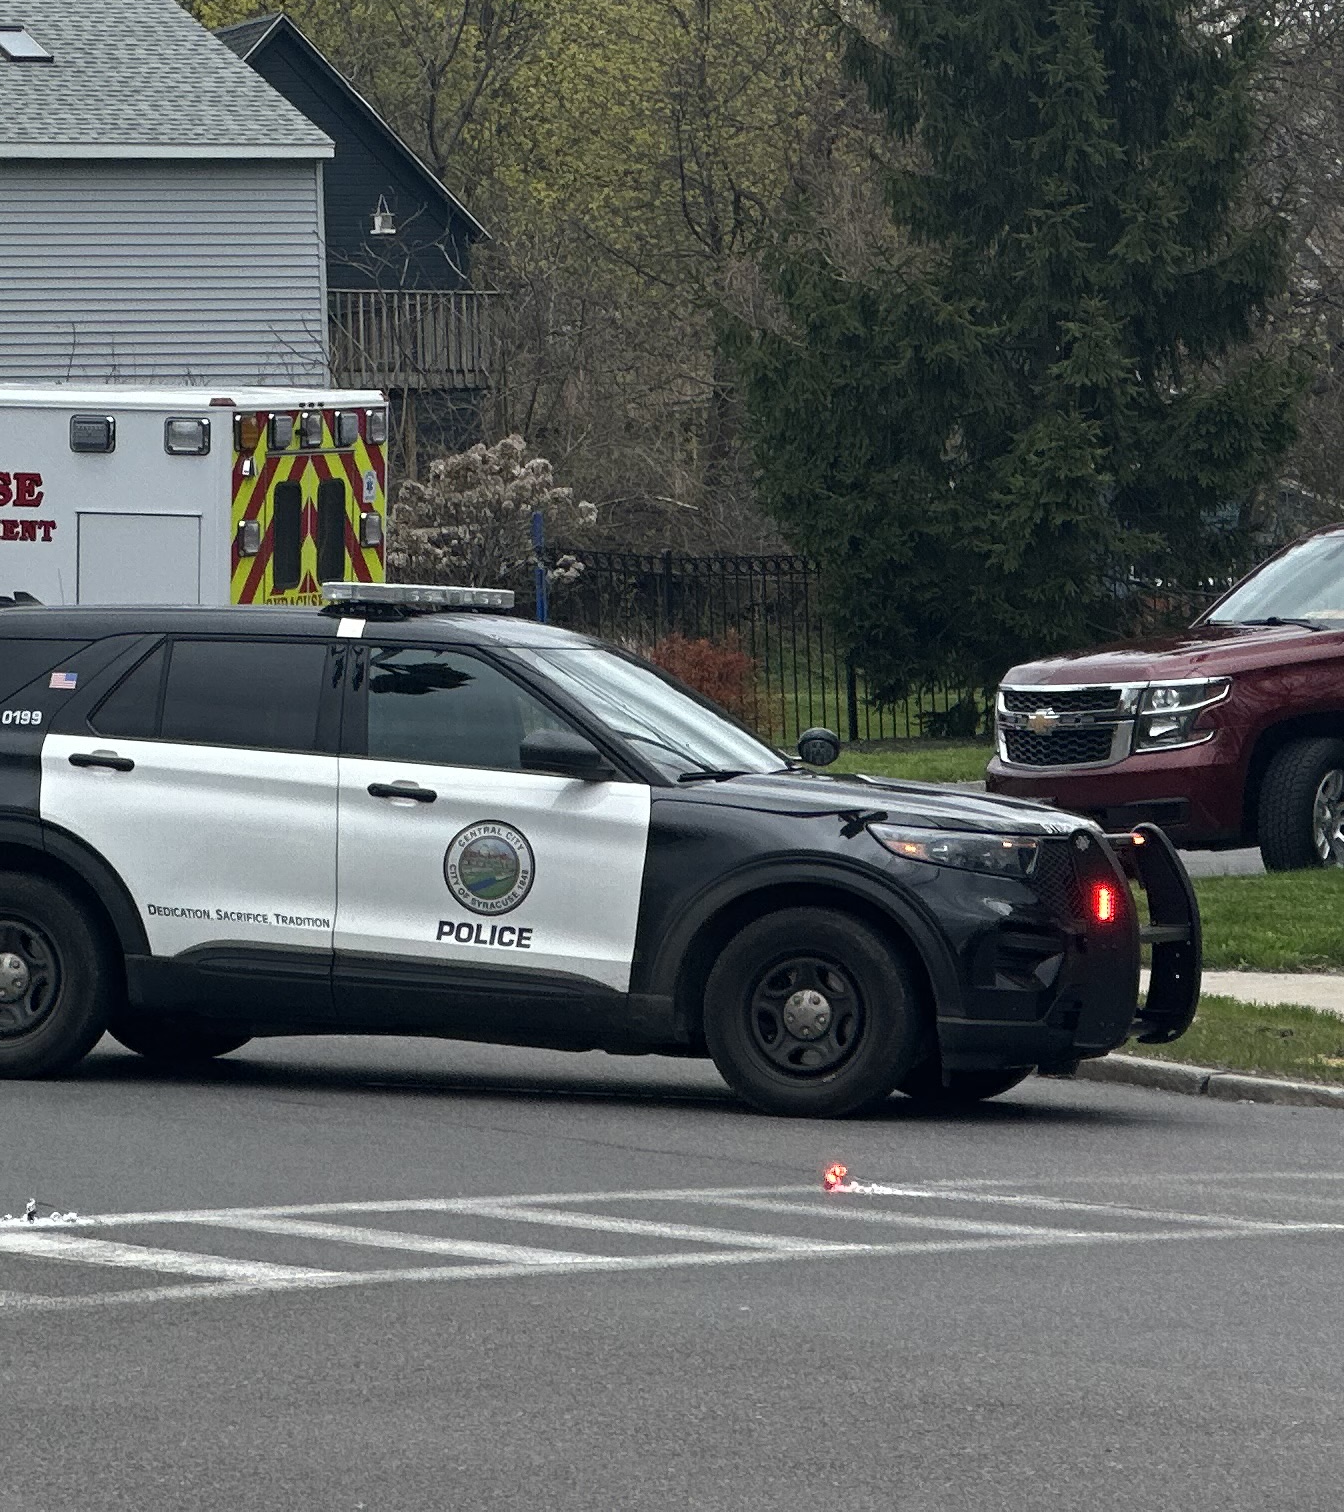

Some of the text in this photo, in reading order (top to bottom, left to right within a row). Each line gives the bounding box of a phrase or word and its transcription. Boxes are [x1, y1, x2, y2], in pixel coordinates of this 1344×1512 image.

[1, 710, 43, 725] 0199
[458, 826, 524, 851] CENTRAL CITY
[449, 863, 460, 886] CITY
[458, 887, 470, 899] OF
[471, 890, 520, 909] SYRACUSE
[436, 920, 533, 949] POLICE
